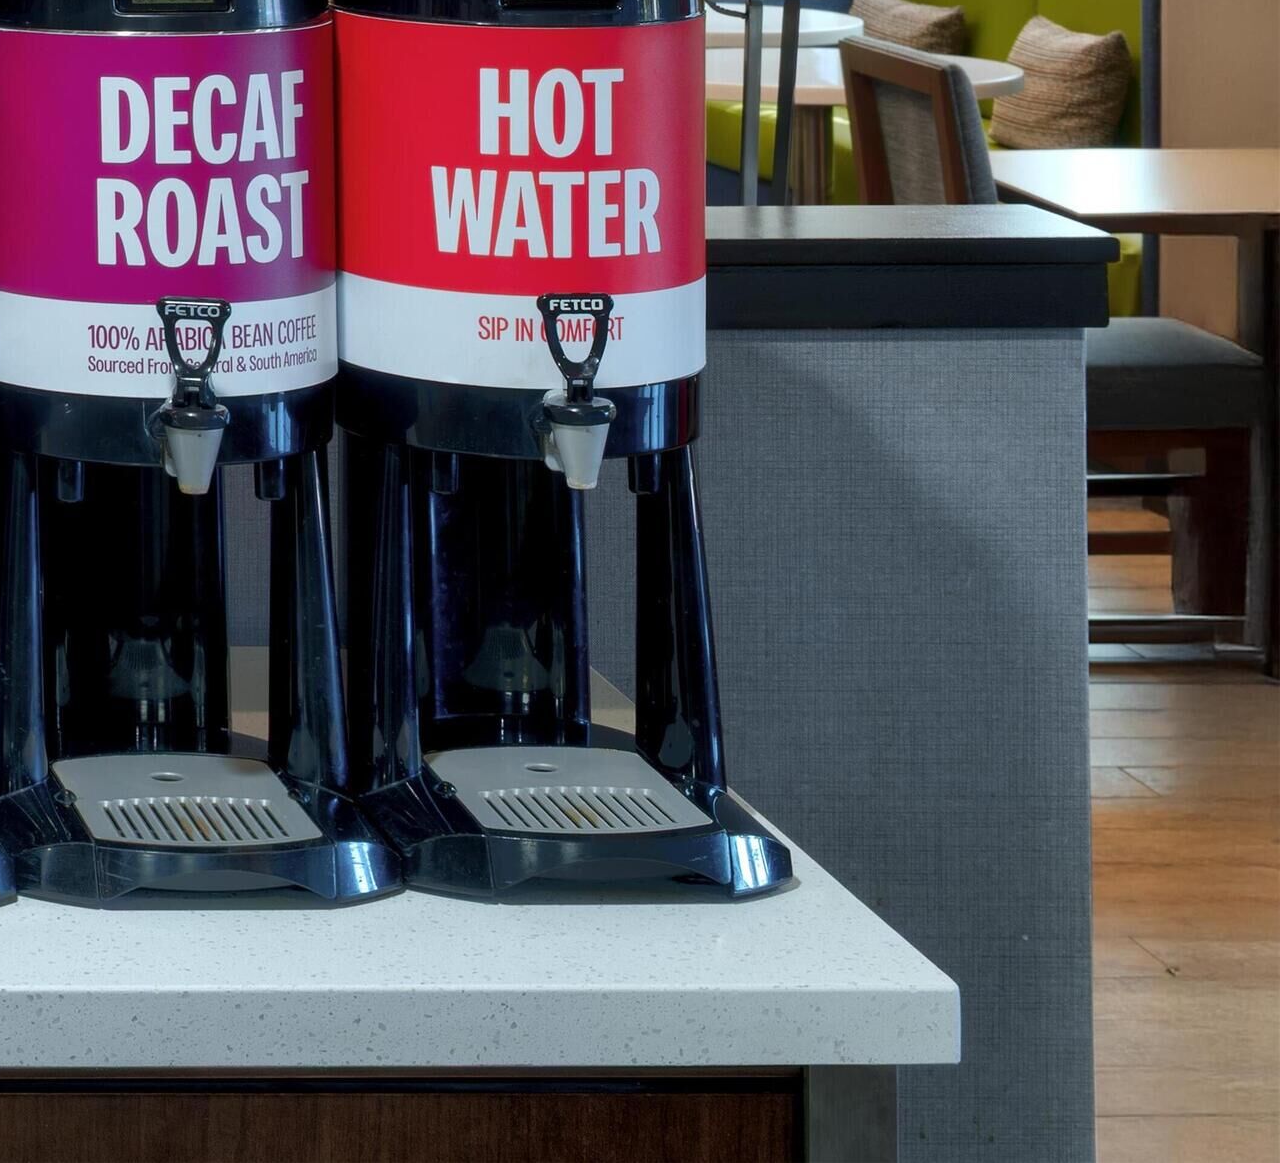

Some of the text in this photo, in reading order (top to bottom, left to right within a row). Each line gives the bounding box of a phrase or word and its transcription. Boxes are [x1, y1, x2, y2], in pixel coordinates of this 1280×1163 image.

[99, 69, 305, 165] DECAF
[478, 67, 625, 159] HOT
[96, 169, 310, 268] ROAST
[430, 165, 662, 259] WATER
[164, 304, 221, 318] FETCO
[549, 299, 604, 311] FETCO
[88, 324, 140, 351] 100%
[231, 323, 274, 349] BEAN
[278, 314, 317, 345] COFFEE
[478, 315, 509, 341] SIP
[515, 318, 534, 342] IN
[87, 355, 144, 375] Sourced
[147, 358, 175, 375] Fro
[239, 356, 247, 372] &
[249, 353, 282, 371] South
[284, 348, 318, 366] America
